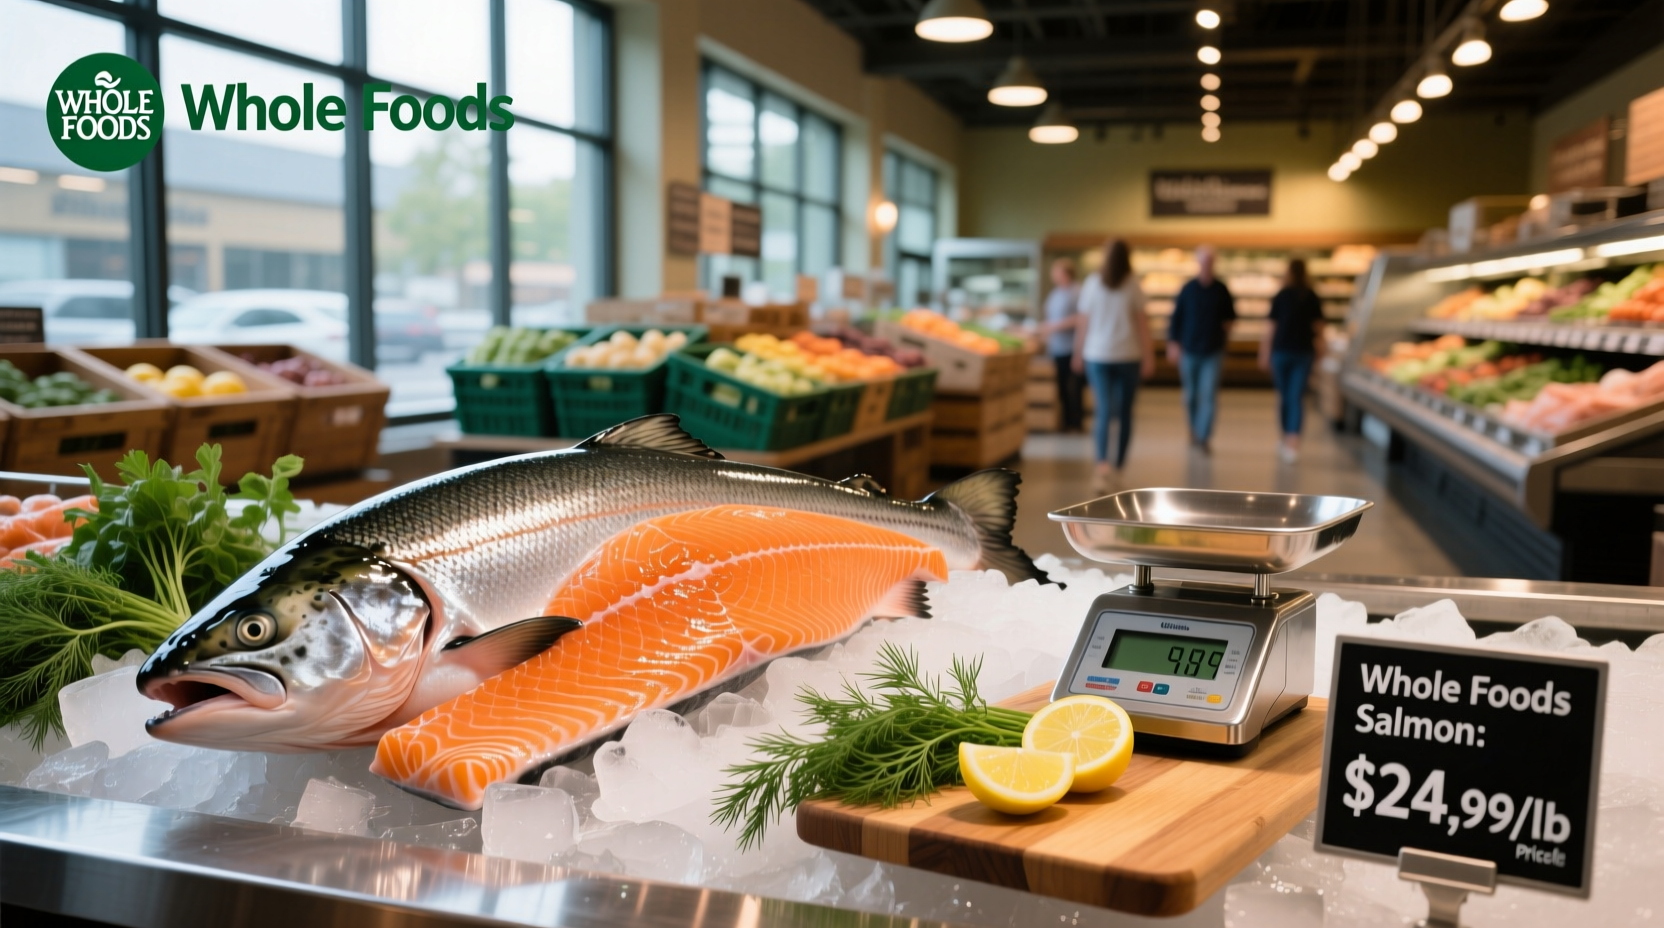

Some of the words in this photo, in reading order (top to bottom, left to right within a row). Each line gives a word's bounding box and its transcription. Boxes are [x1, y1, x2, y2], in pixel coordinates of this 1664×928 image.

[1360, 663, 1462, 703] Whole
[1469, 675, 1572, 716] Foods
[1355, 703, 1486, 748] Salmon:
